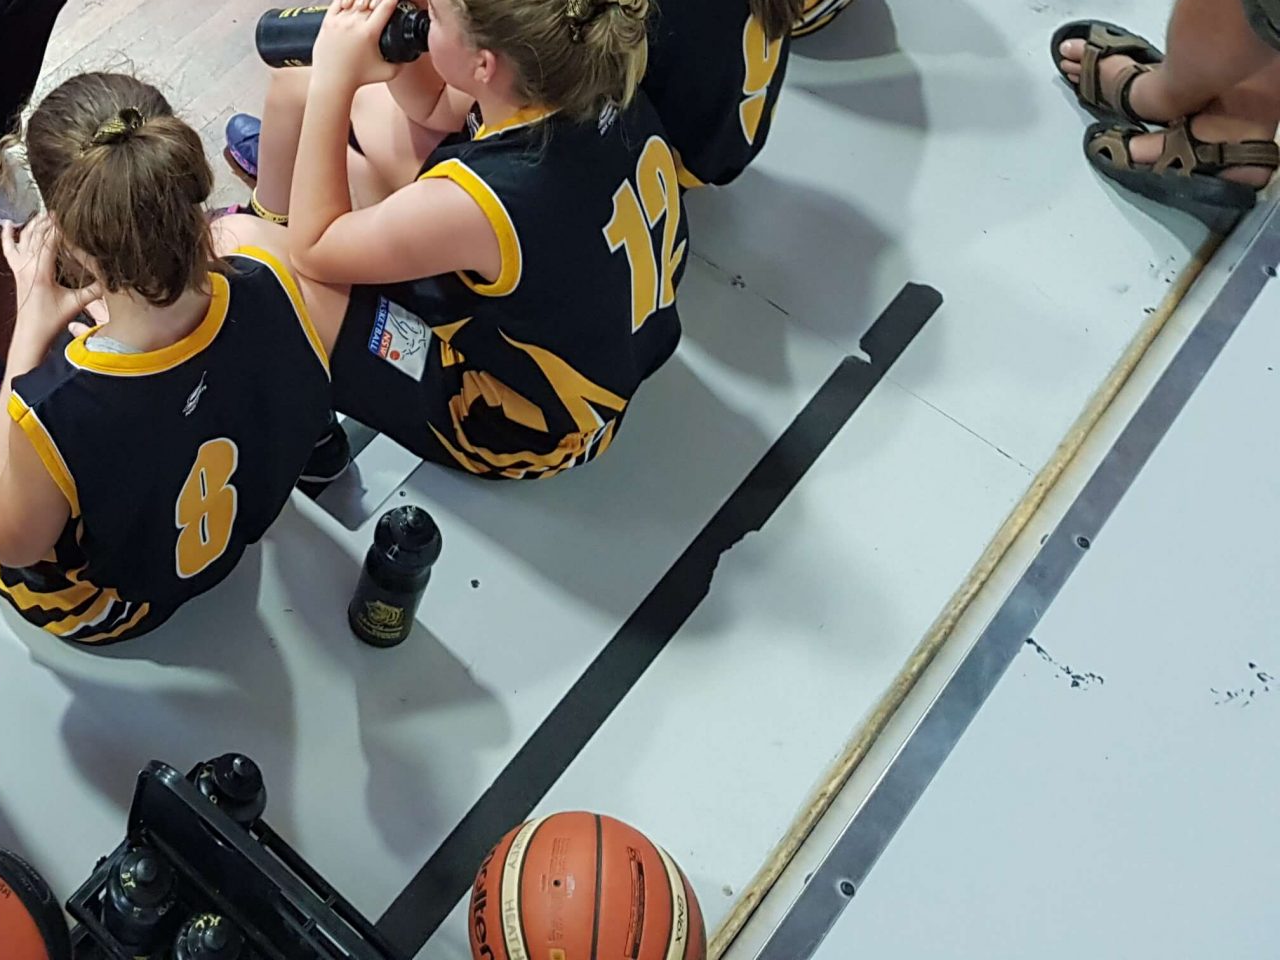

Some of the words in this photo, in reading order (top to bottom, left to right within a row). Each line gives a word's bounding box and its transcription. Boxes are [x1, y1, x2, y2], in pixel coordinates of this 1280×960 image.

[739, 14, 785, 146] 9
[602, 134, 687, 333] 12
[175, 437, 238, 579] 8
